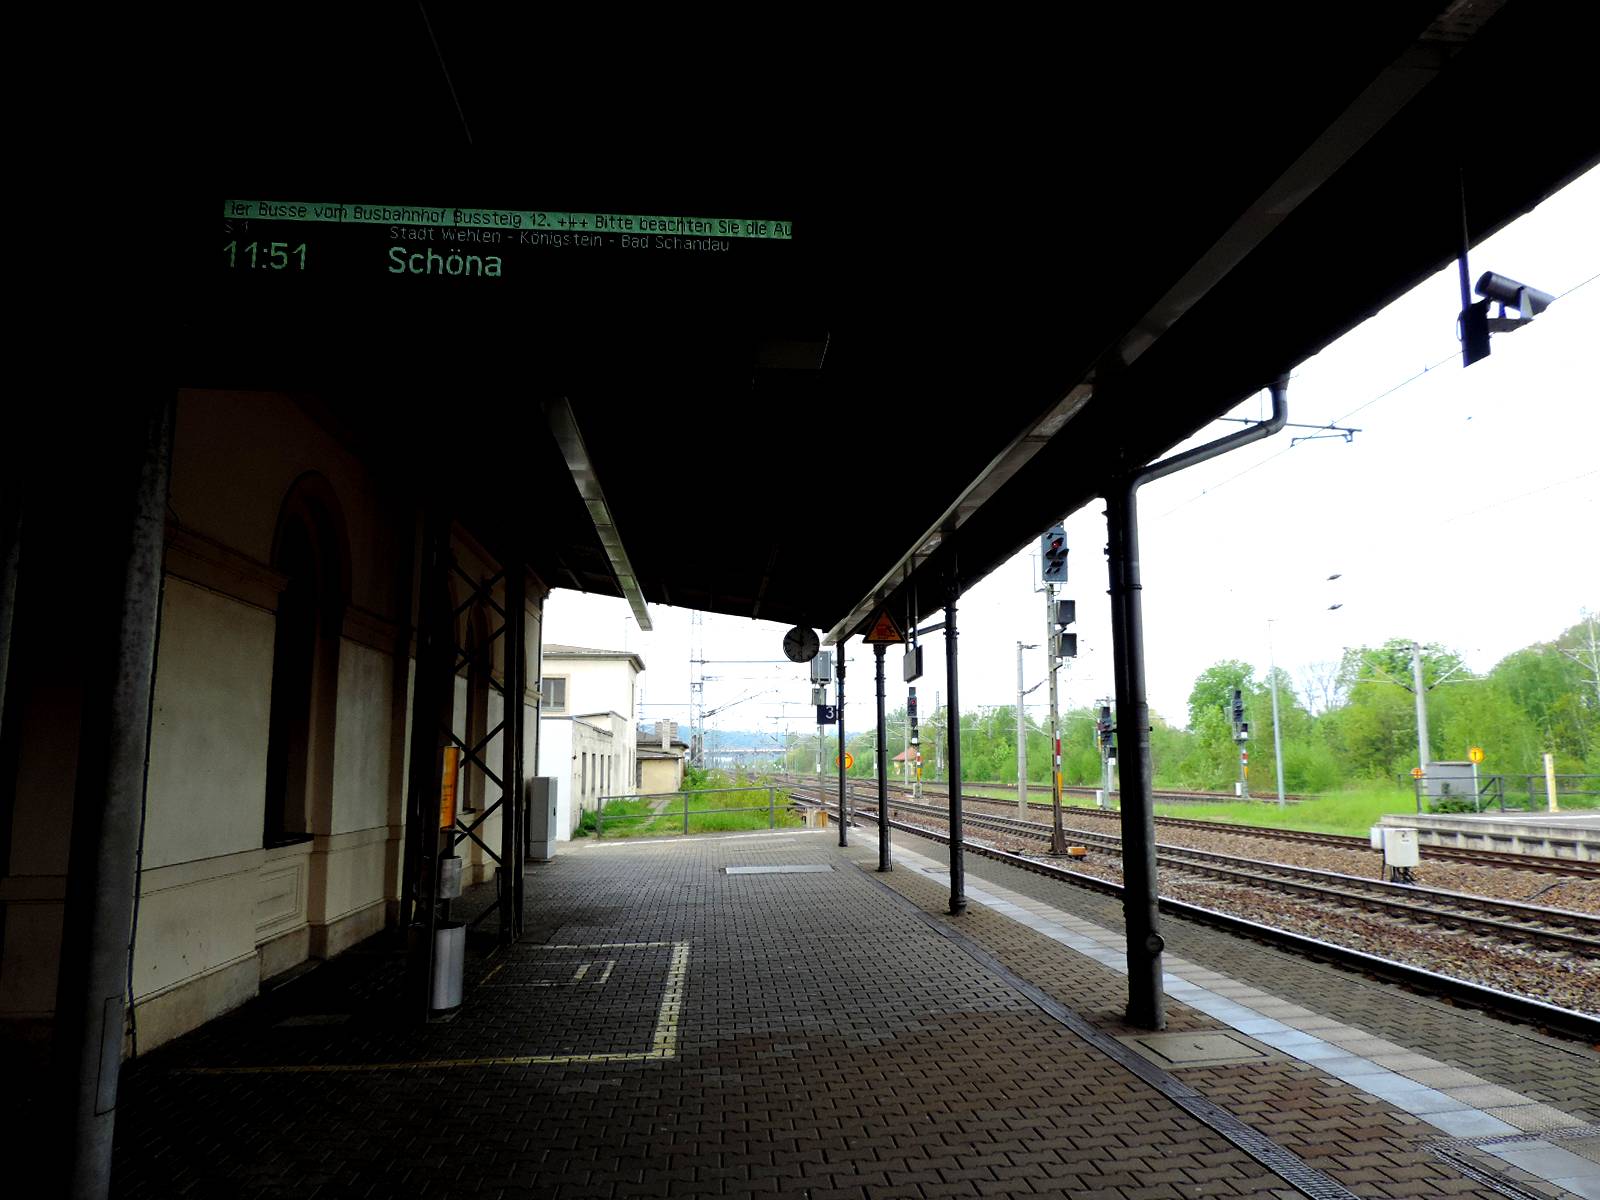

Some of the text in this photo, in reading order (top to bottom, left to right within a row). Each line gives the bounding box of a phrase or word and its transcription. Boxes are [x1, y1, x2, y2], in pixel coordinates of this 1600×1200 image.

[258, 202, 307, 218] Busse
[314, 205, 348, 220] vom
[353, 207, 446, 223] Busbahnhof
[453, 209, 522, 228] Bussteig
[530, 213, 551, 227] 12.
[595, 215, 633, 230] Bitte
[639, 218, 712, 233] beachten
[718, 221, 740, 234] Sie
[746, 222, 768, 235] die
[390, 226, 433, 241] Stadt
[443, 228, 500, 244] Wehlen
[520, 232, 602, 247] Königstein
[622, 236, 649, 249] Bad
[656, 237, 730, 252] Schandau
[223, 240, 306, 270] 11:51
[388, 246, 502, 279] Schöna
[825, 707, 834, 719] 3
